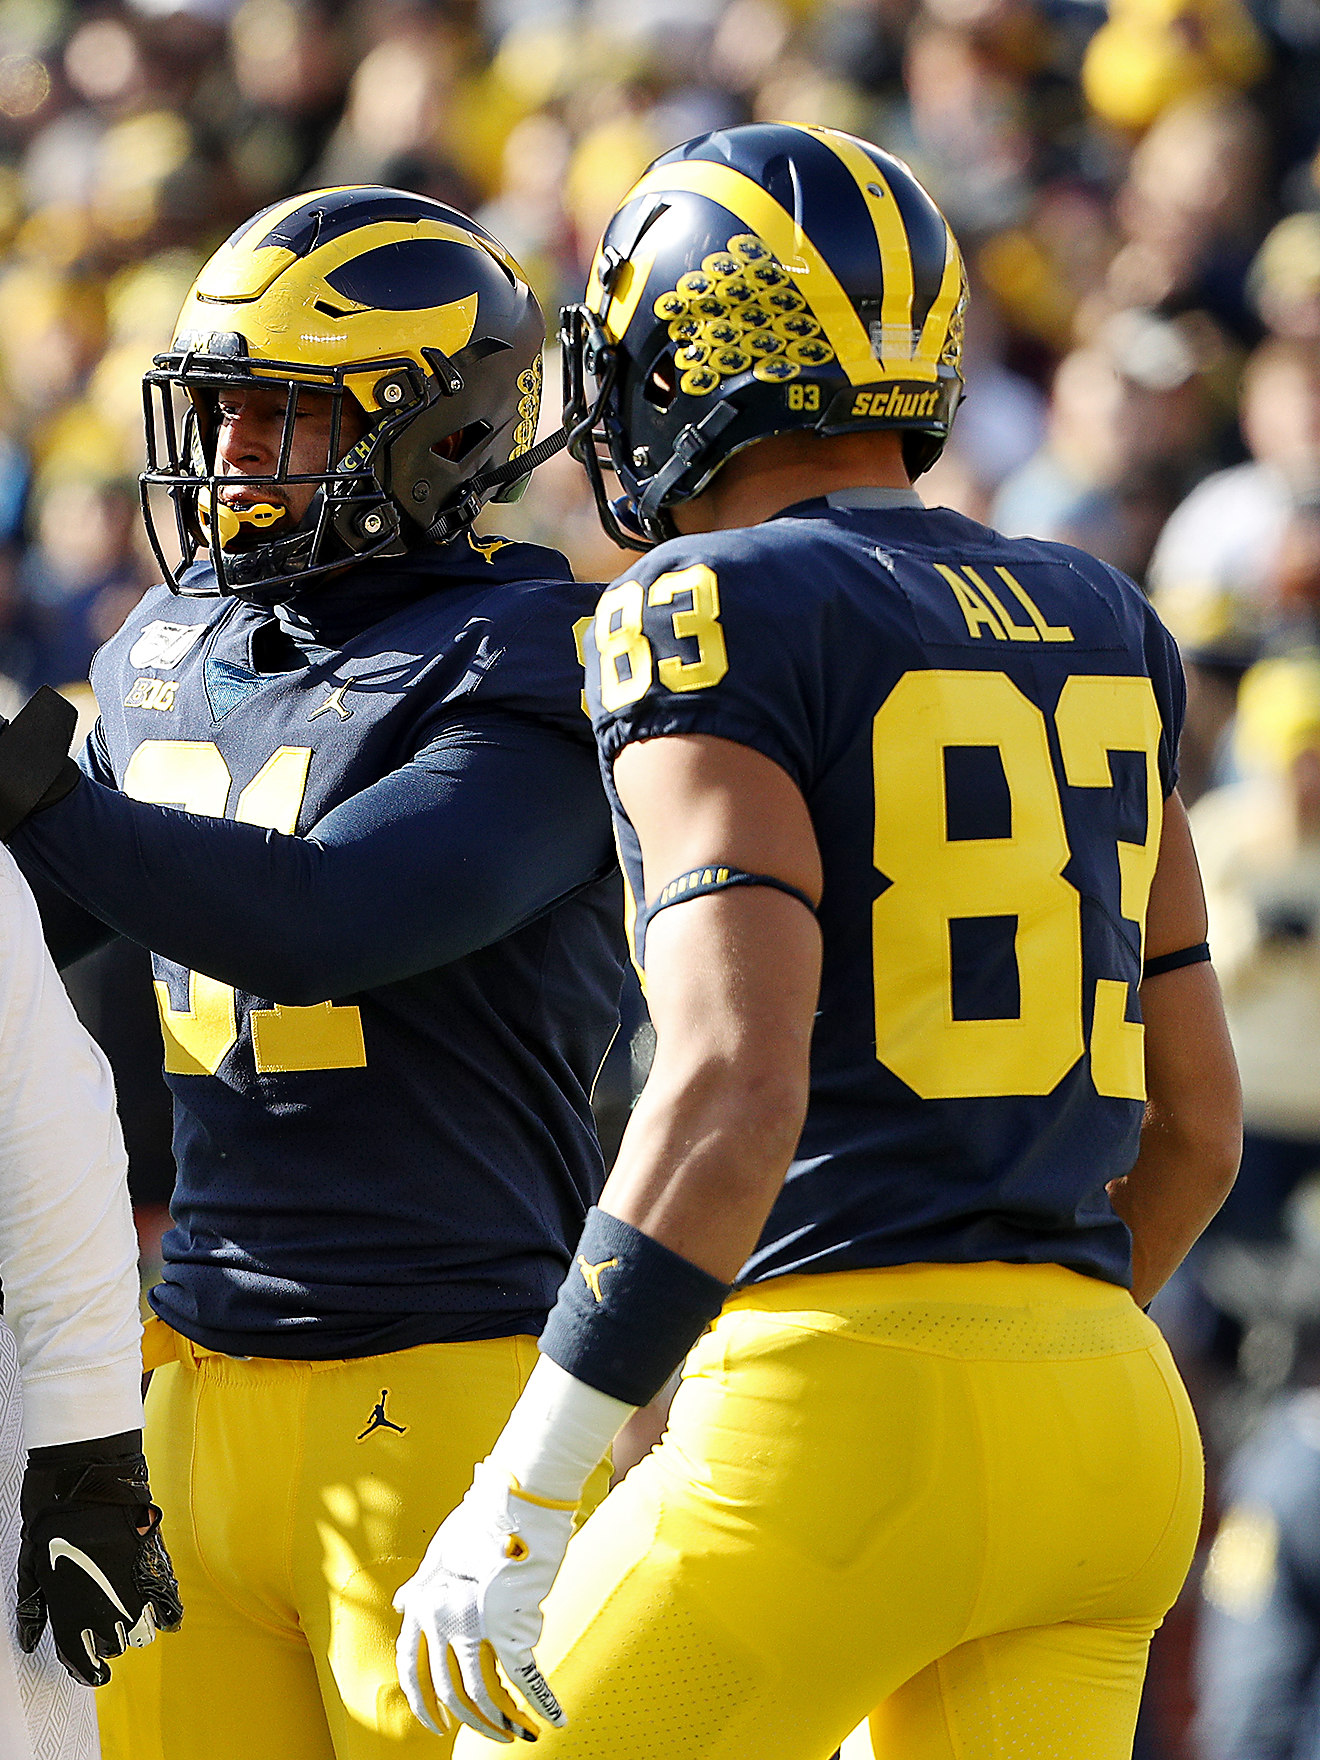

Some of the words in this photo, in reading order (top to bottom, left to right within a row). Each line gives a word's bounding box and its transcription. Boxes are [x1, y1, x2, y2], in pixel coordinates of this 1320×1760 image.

[788, 384, 821, 411] 83
[851, 385, 940, 417] schutt
[594, 563, 730, 714] 83
[932, 562, 1076, 642] ALL
[871, 668, 1164, 1102] 83
